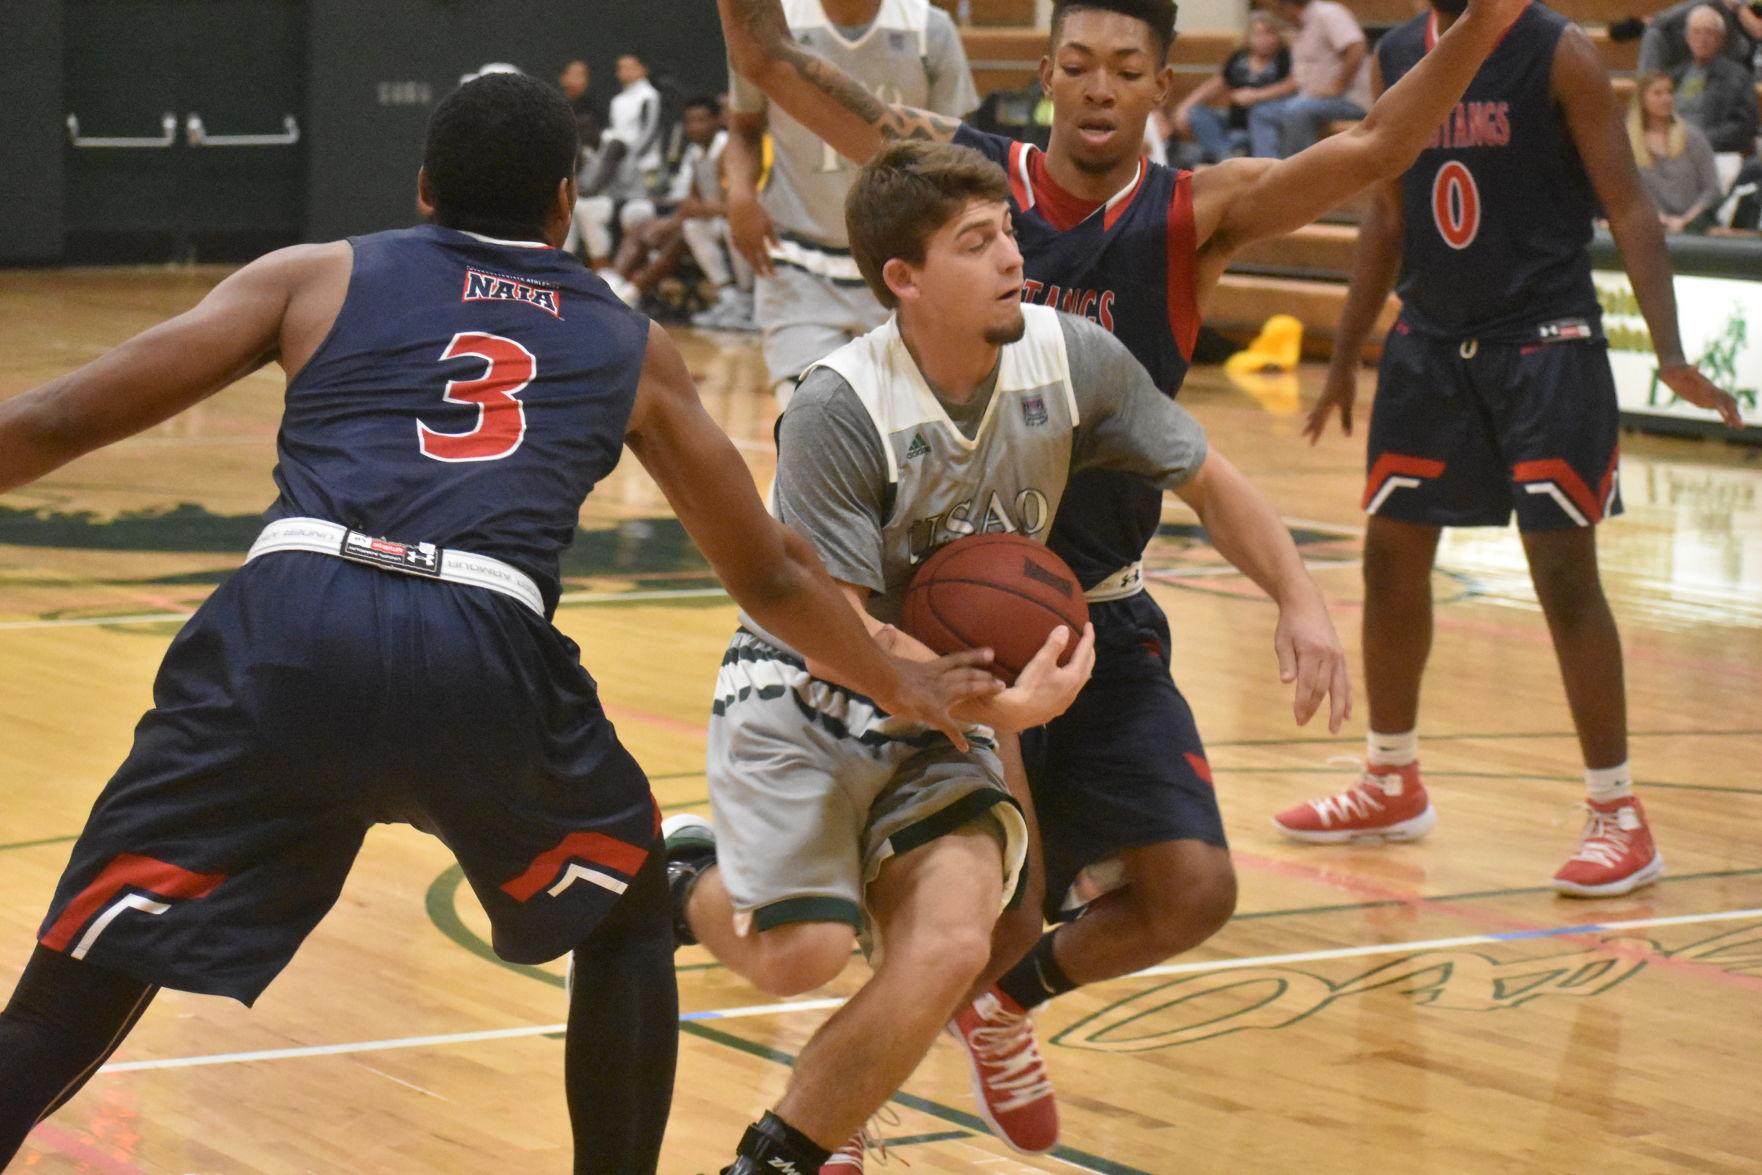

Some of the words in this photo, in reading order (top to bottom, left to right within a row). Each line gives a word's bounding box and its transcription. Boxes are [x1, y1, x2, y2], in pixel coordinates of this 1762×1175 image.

[1431, 101, 1511, 149] TANGS
[1431, 160, 1481, 249] 0
[464, 270, 558, 314] NAIA
[1022, 278, 1115, 333] TANGS
[416, 331, 537, 462] 3
